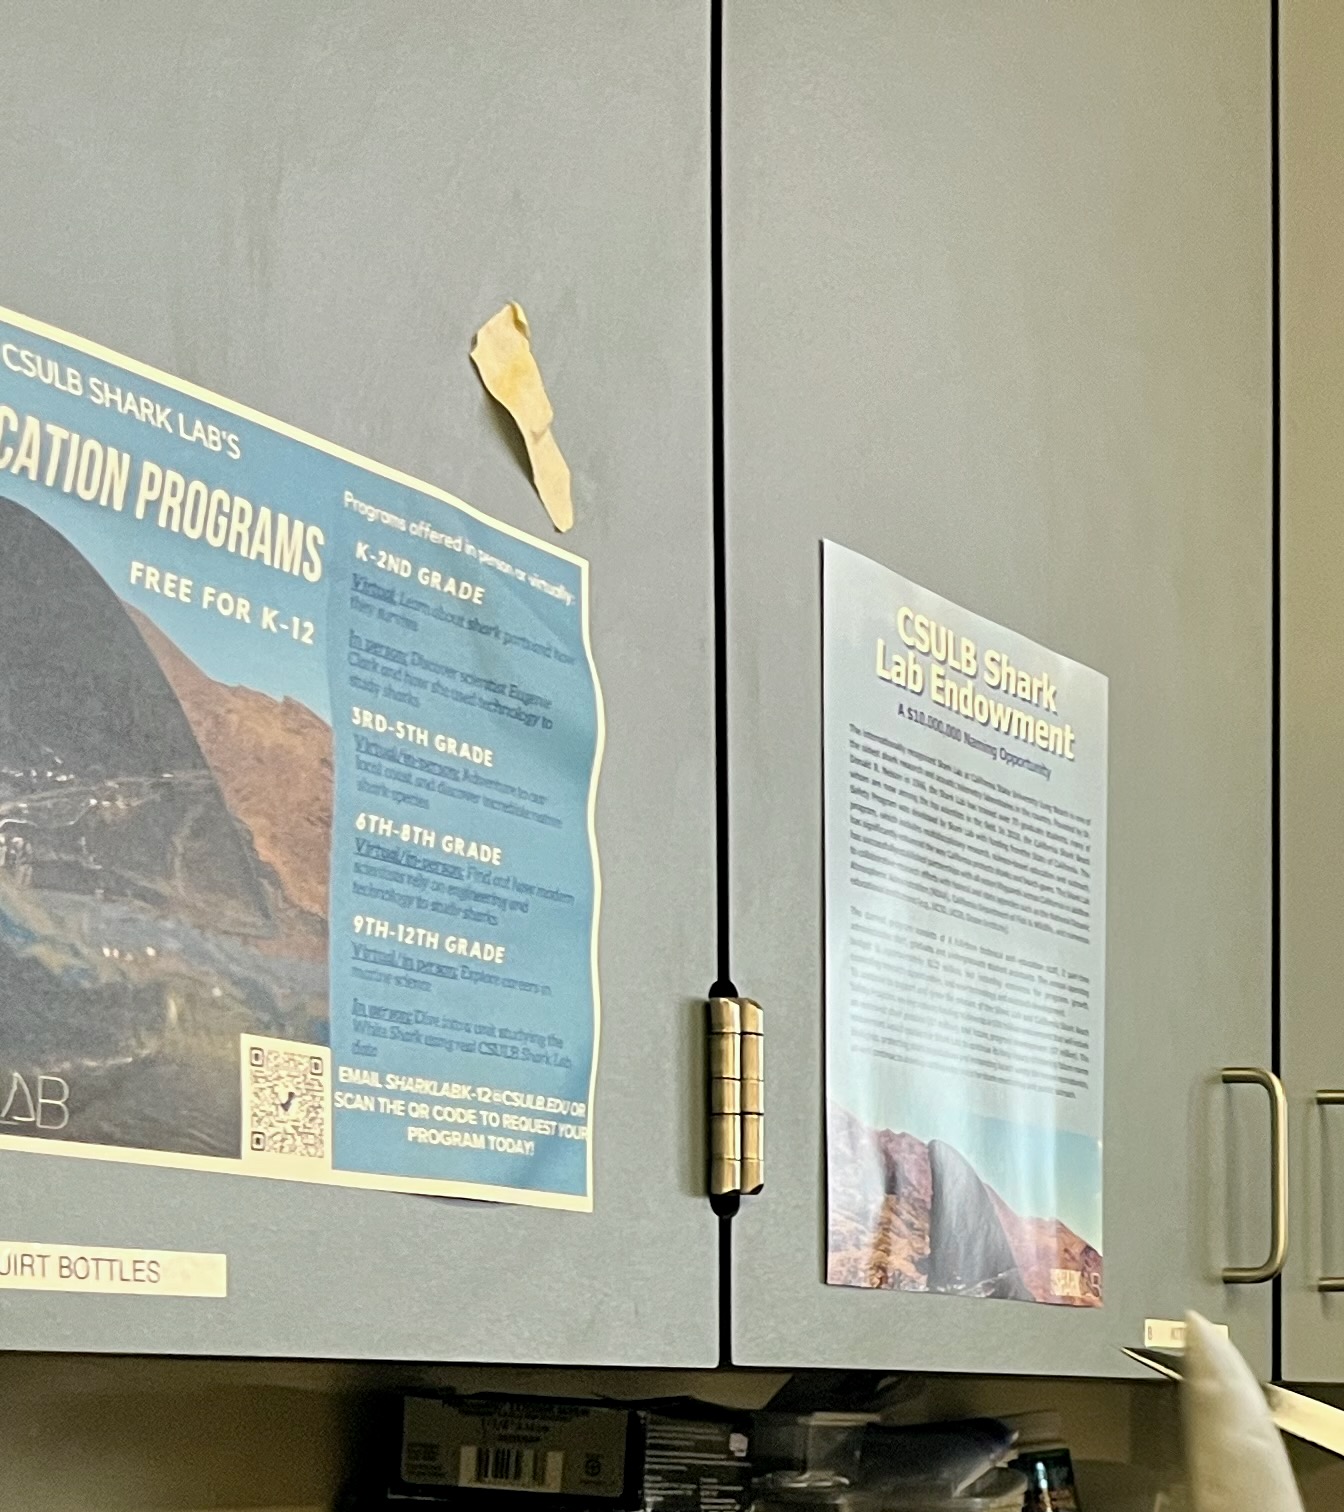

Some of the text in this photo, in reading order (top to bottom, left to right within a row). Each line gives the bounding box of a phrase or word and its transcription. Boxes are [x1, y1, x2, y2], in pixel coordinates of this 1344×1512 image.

[2, 343, 241, 460] CSULB SHARK LAB'S
[134, 460, 325, 583] PROGRAMS
[343, 490, 406, 533] Programs
[408, 520, 463, 553] offered
[130, 560, 315, 645] FREE FOR K-12
[355, 540, 486, 605] K-2ND GRADE
[897, 605, 1059, 716] CSULB Shark
[875, 637, 1076, 762] Lab Endowment
[351, 705, 430, 748] 3RD-5TH
[433, 734, 494, 768] GRADE
[355, 812, 436, 849] 6TH-8TH
[441, 835, 503, 867] GRADE
[353, 914, 506, 964] 9TH-12TH GRADE
[0, 1070, 70, 1130] AB
[338, 1066, 383, 1089] EMAIL
[333, 1090, 376, 1114] SCAN
[377, 1096, 406, 1117] THE
[407, 1101, 430, 1121] QR
[432, 1105, 478, 1126] CODE
[479, 1110, 500, 1128] TO
[502, 1112, 557, 1137] REQUEST
[407, 1125, 535, 1157] PROGRAM TODAY!
[58, 1254, 162, 1284] BOTTLES
